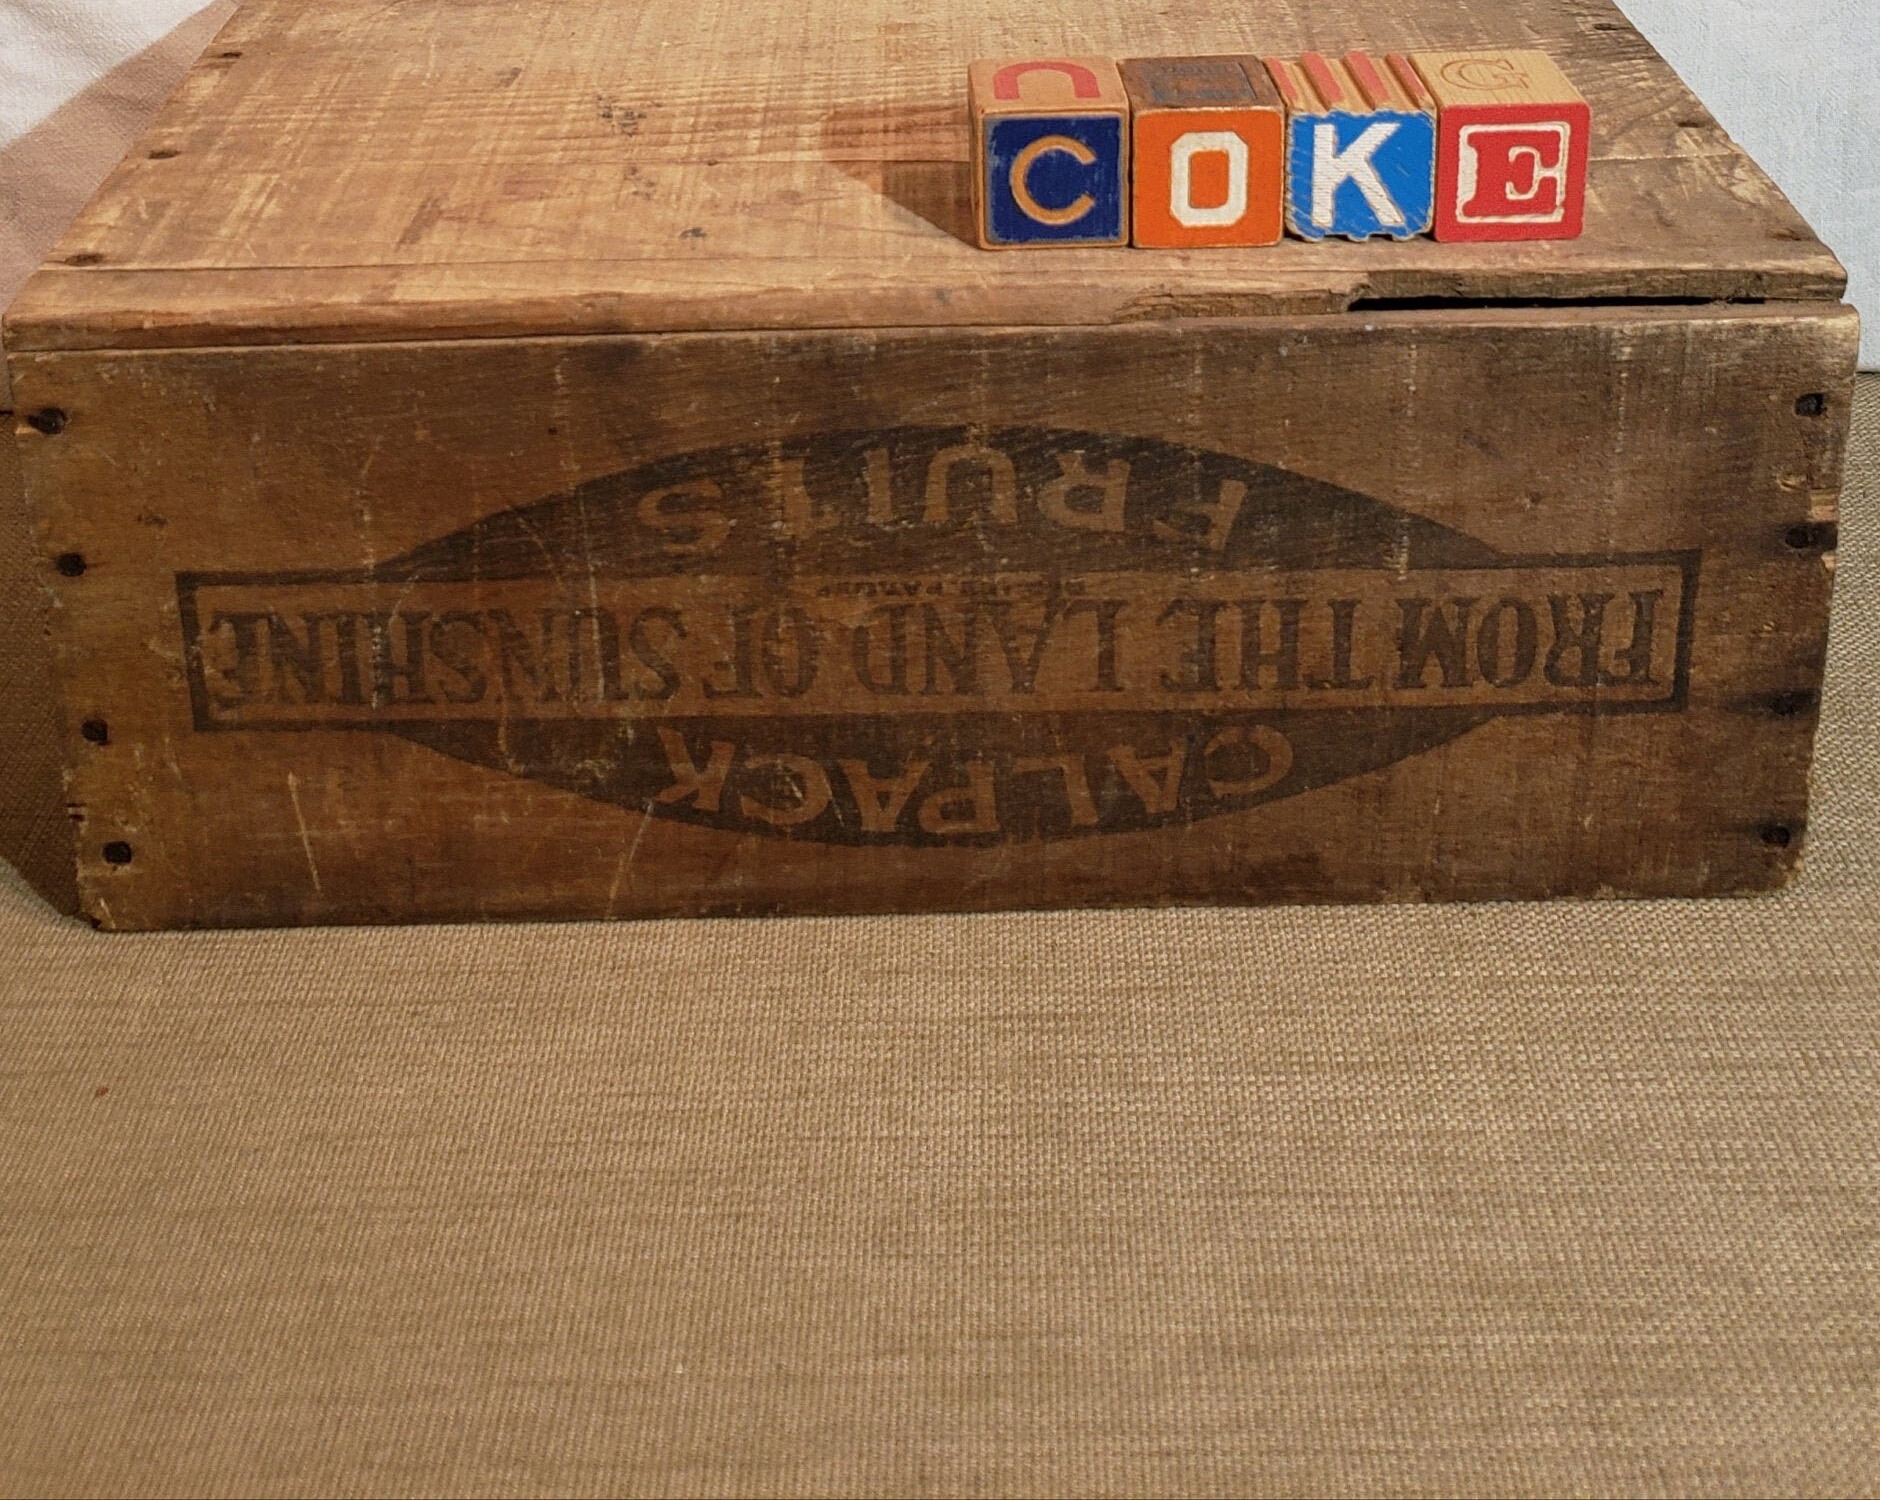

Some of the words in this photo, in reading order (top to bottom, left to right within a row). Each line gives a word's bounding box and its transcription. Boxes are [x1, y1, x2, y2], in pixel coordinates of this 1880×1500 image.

[638, 443, 1249, 558] FRUITS
[202, 605, 690, 704] SUNSHINE
[702, 603, 820, 699] OF
[848, 598, 1123, 695] LAND
[1156, 598, 1373, 693] THE
[1392, 589, 1665, 691] FROM
